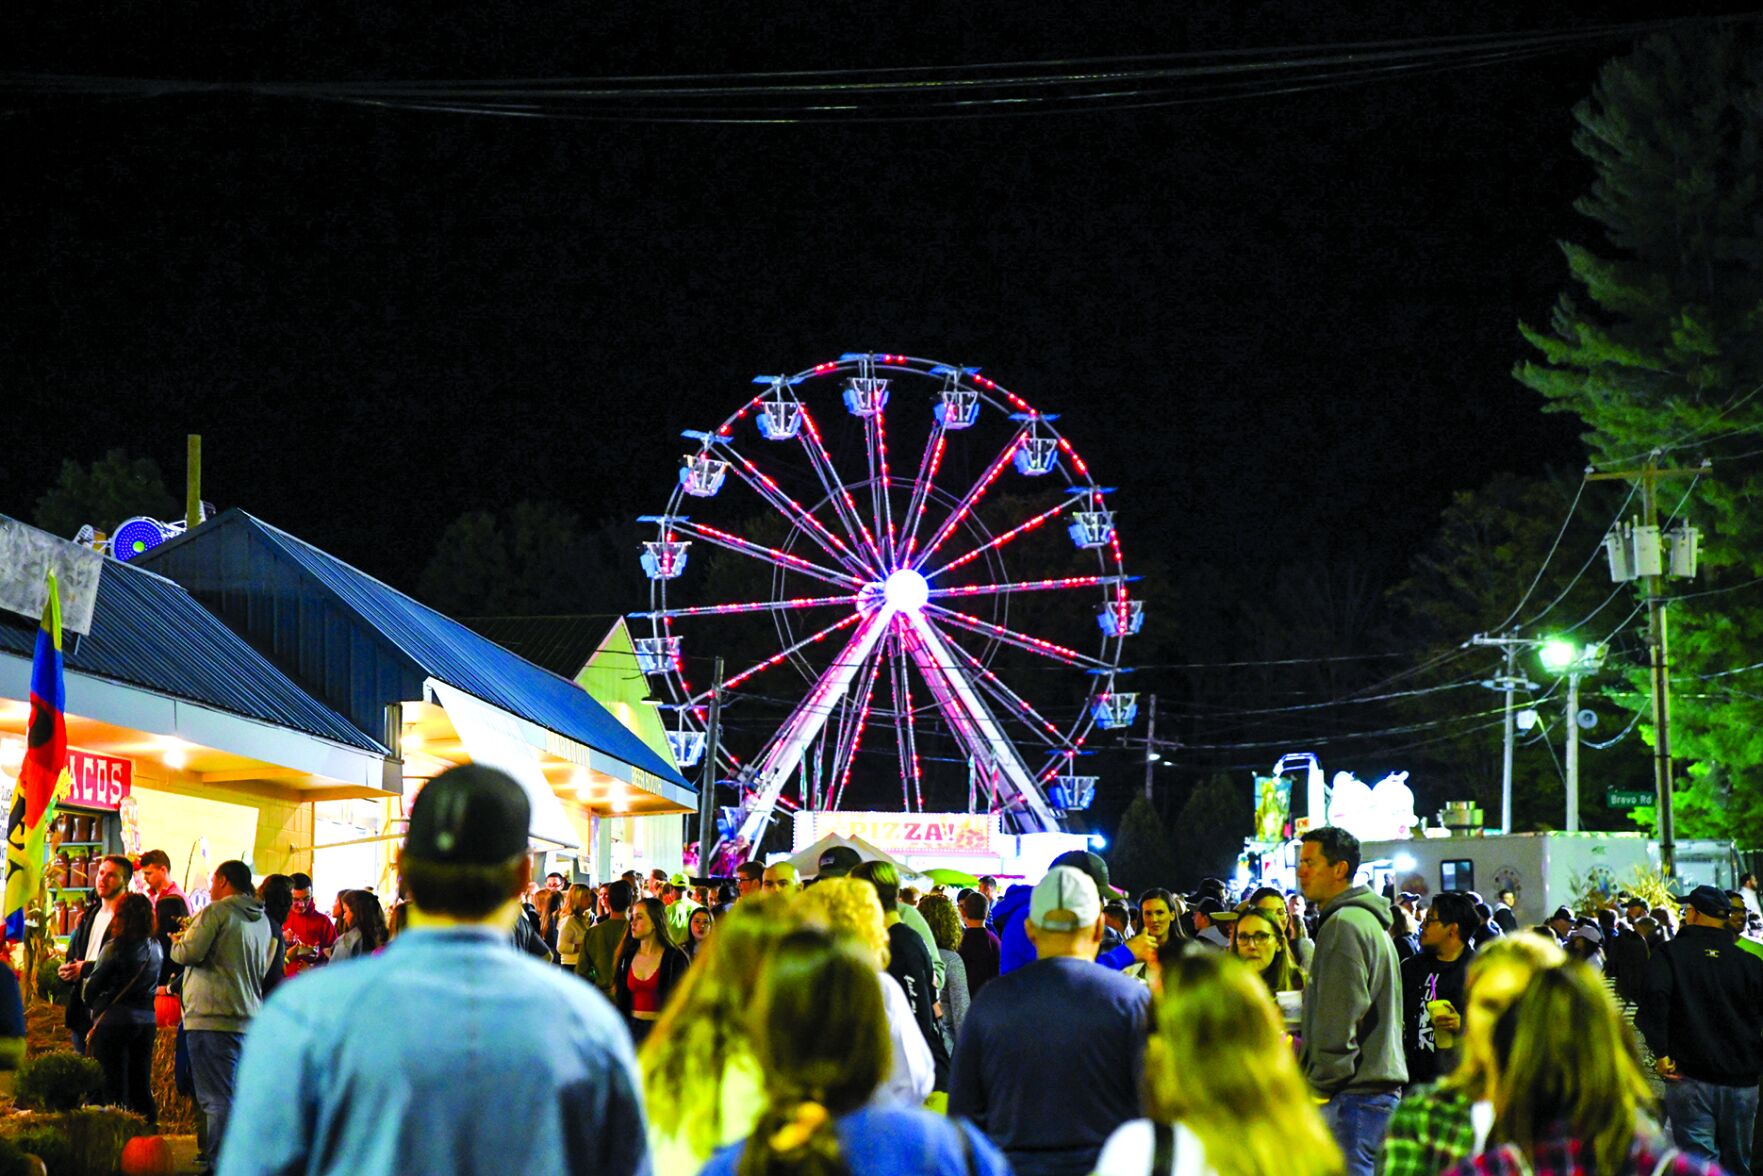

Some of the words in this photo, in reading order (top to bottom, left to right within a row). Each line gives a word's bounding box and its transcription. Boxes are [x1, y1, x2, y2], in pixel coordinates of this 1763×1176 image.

[67, 755, 123, 805] ACOS
[1640, 795, 1652, 805] Rd
[850, 821, 955, 842] PIZZA!
